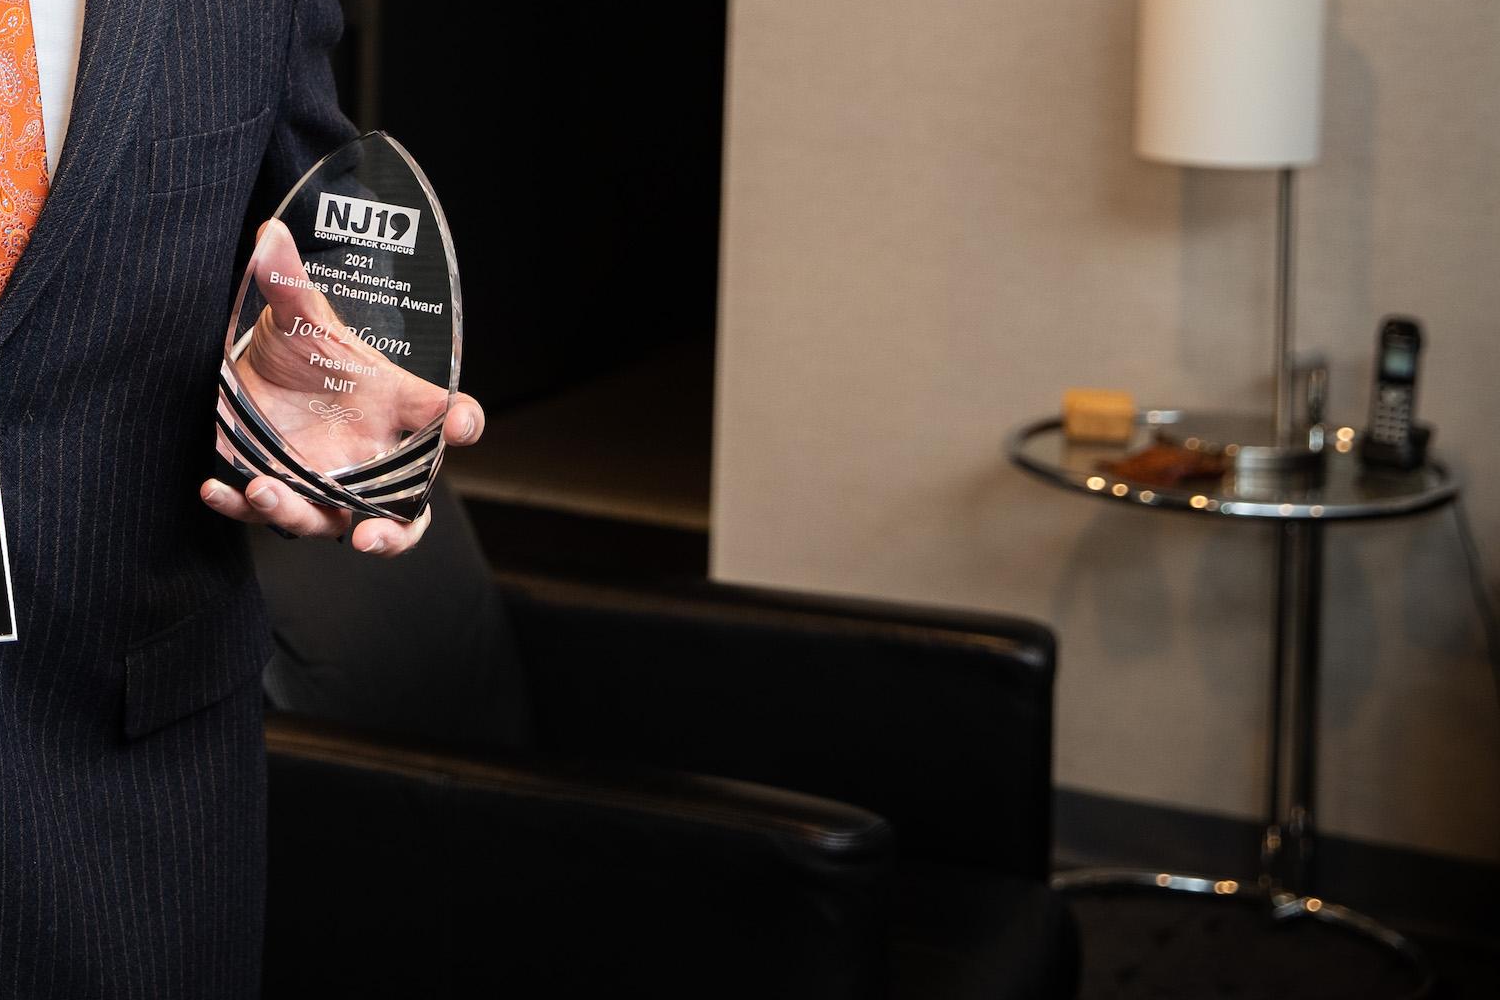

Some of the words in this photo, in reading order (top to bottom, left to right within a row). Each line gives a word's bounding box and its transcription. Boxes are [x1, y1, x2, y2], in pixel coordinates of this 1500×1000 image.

[324, 200, 411, 241] NJ19
[314, 230, 349, 244] COUNTY
[350, 236, 379, 249] BLACK
[379, 243, 415, 255] CAUCUS
[344, 253, 374, 269] 2021
[302, 261, 411, 292] African-American
[269, 271, 329, 293] Business
[332, 283, 398, 307] Champion
[400, 296, 443, 315] Award
[284, 316, 343, 342] Joel
[338, 326, 412, 356] Bloom
[309, 353, 379, 377] President
[323, 376, 357, 394] NJIT
